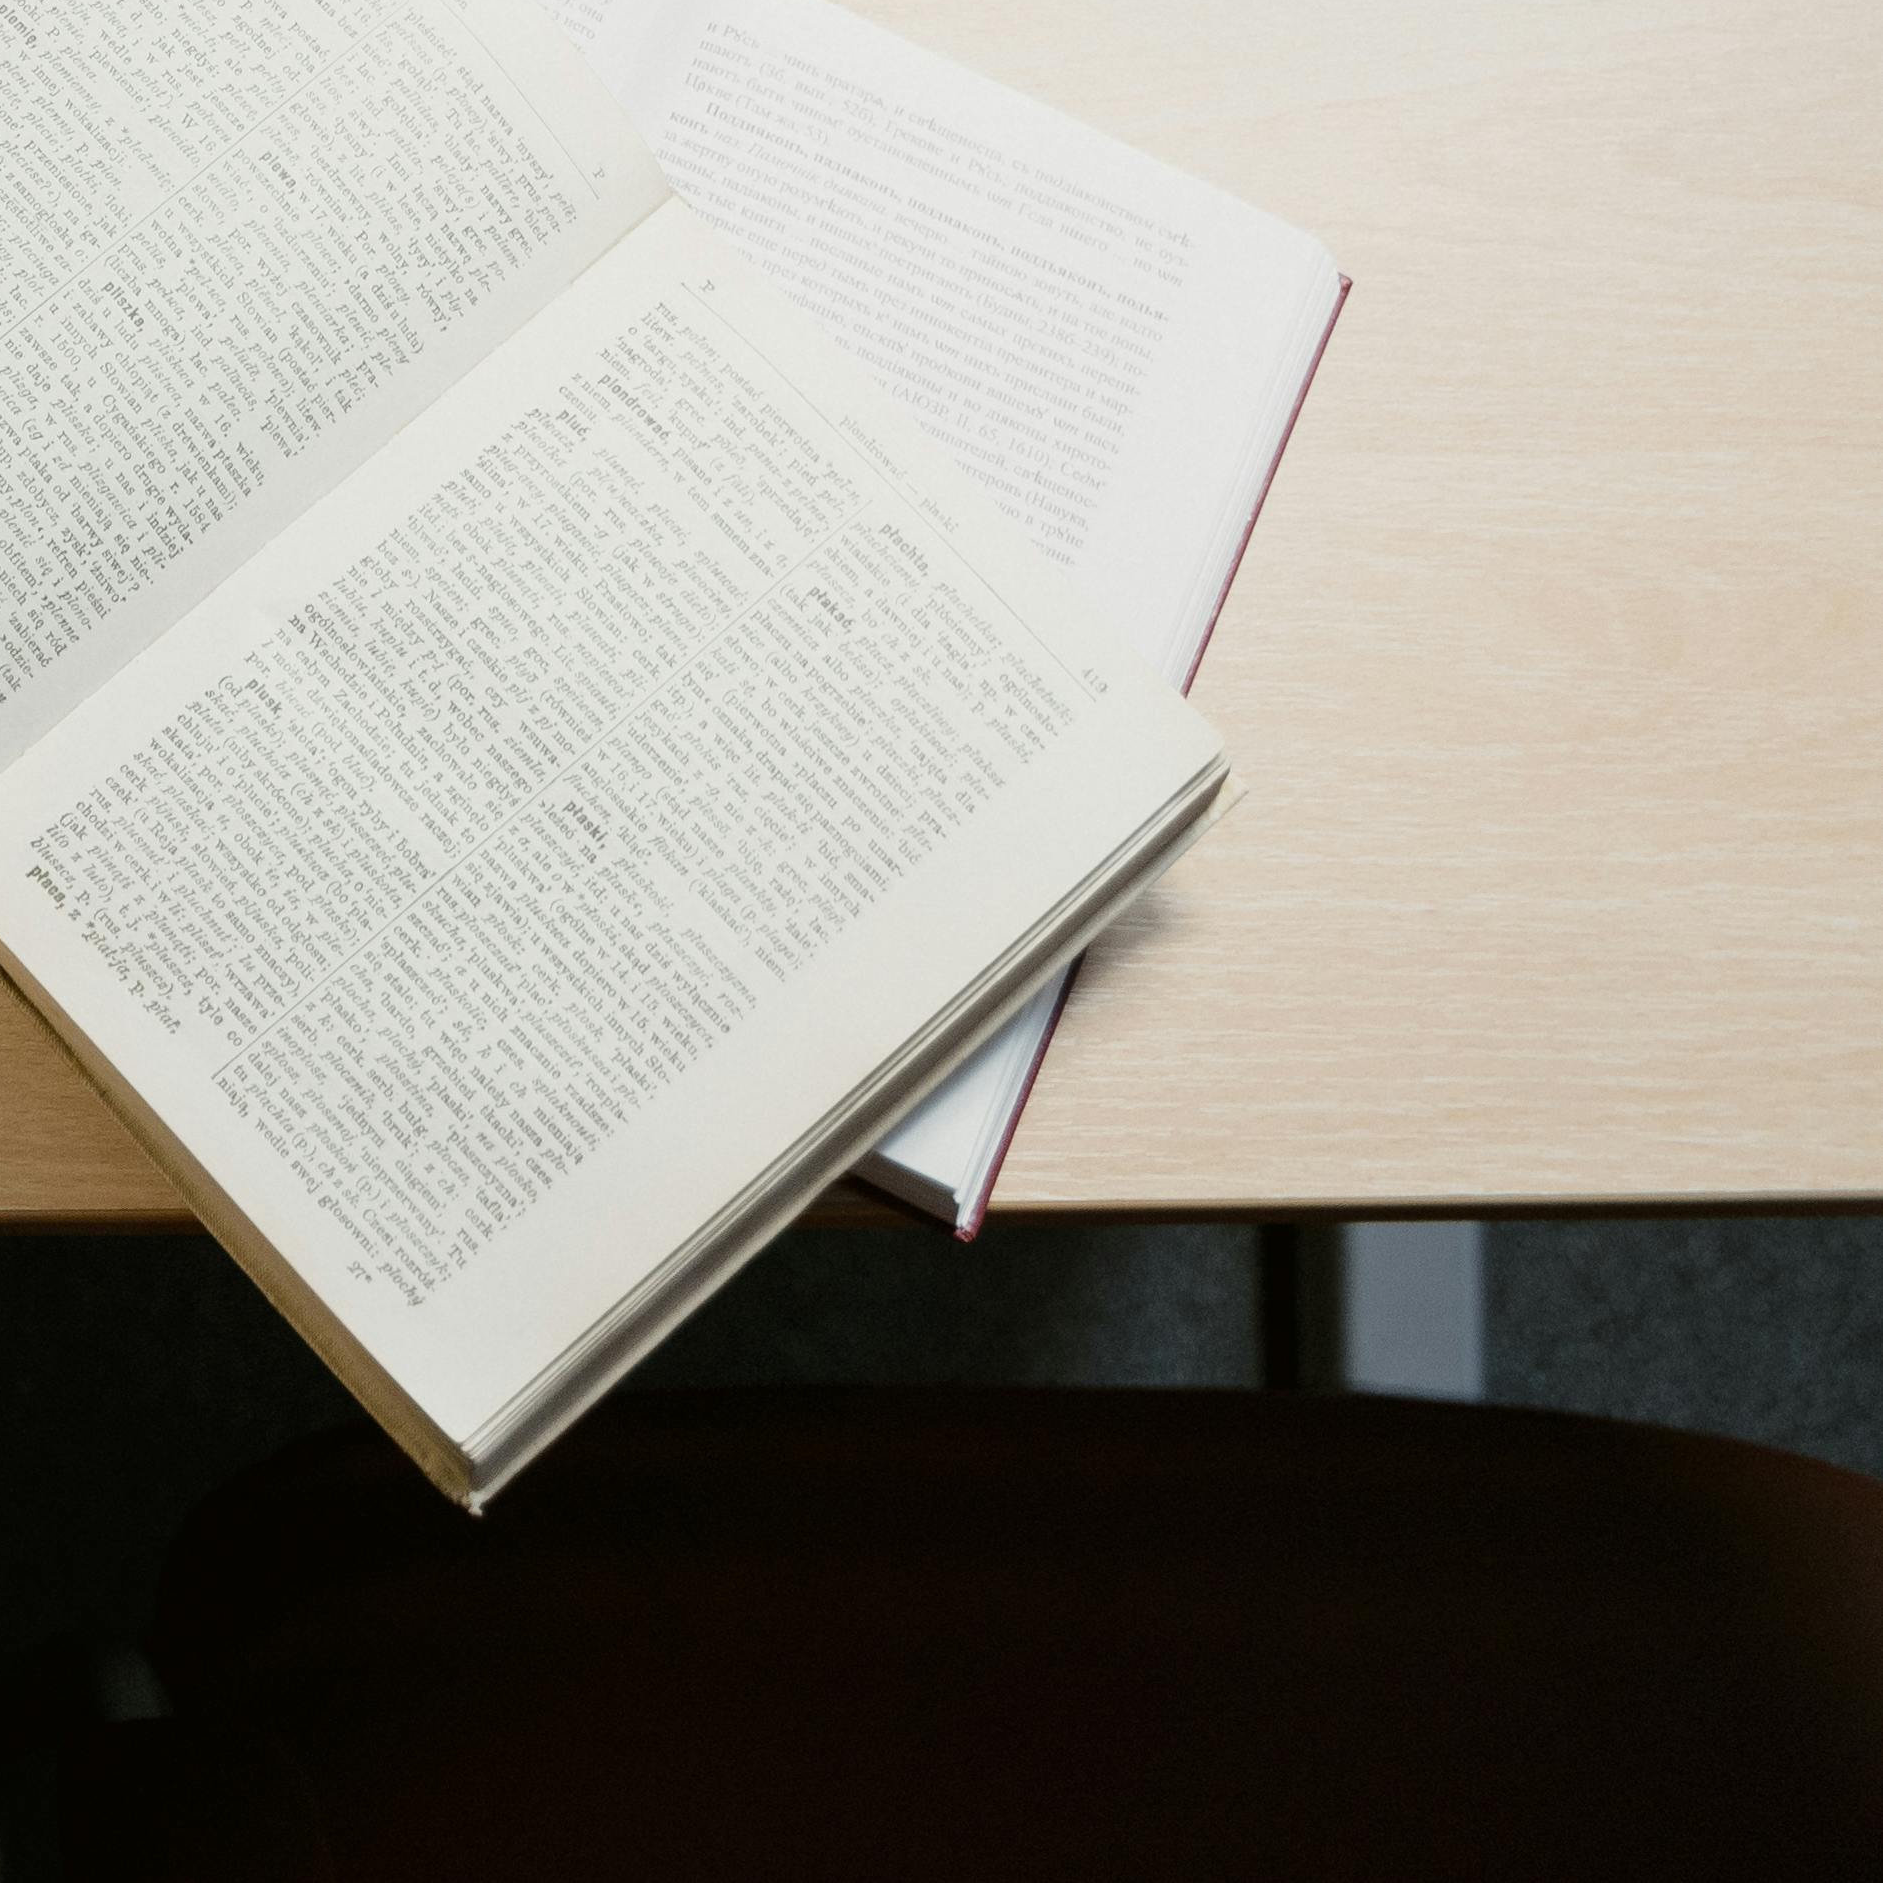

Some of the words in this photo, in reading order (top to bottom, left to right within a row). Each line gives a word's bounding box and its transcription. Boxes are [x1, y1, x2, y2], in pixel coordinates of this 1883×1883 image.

[1081, 667, 1109, 694] 419
[560, 799, 609, 850] płaski,
[477, 848, 518, 891] nazwa
[571, 949, 617, 998] dopiero
[616, 994, 630, 1011] w
[649, 1030, 686, 1073] wieku
[254, 1116, 290, 1159] wedle
[289, 1158, 323, 1195] swej
